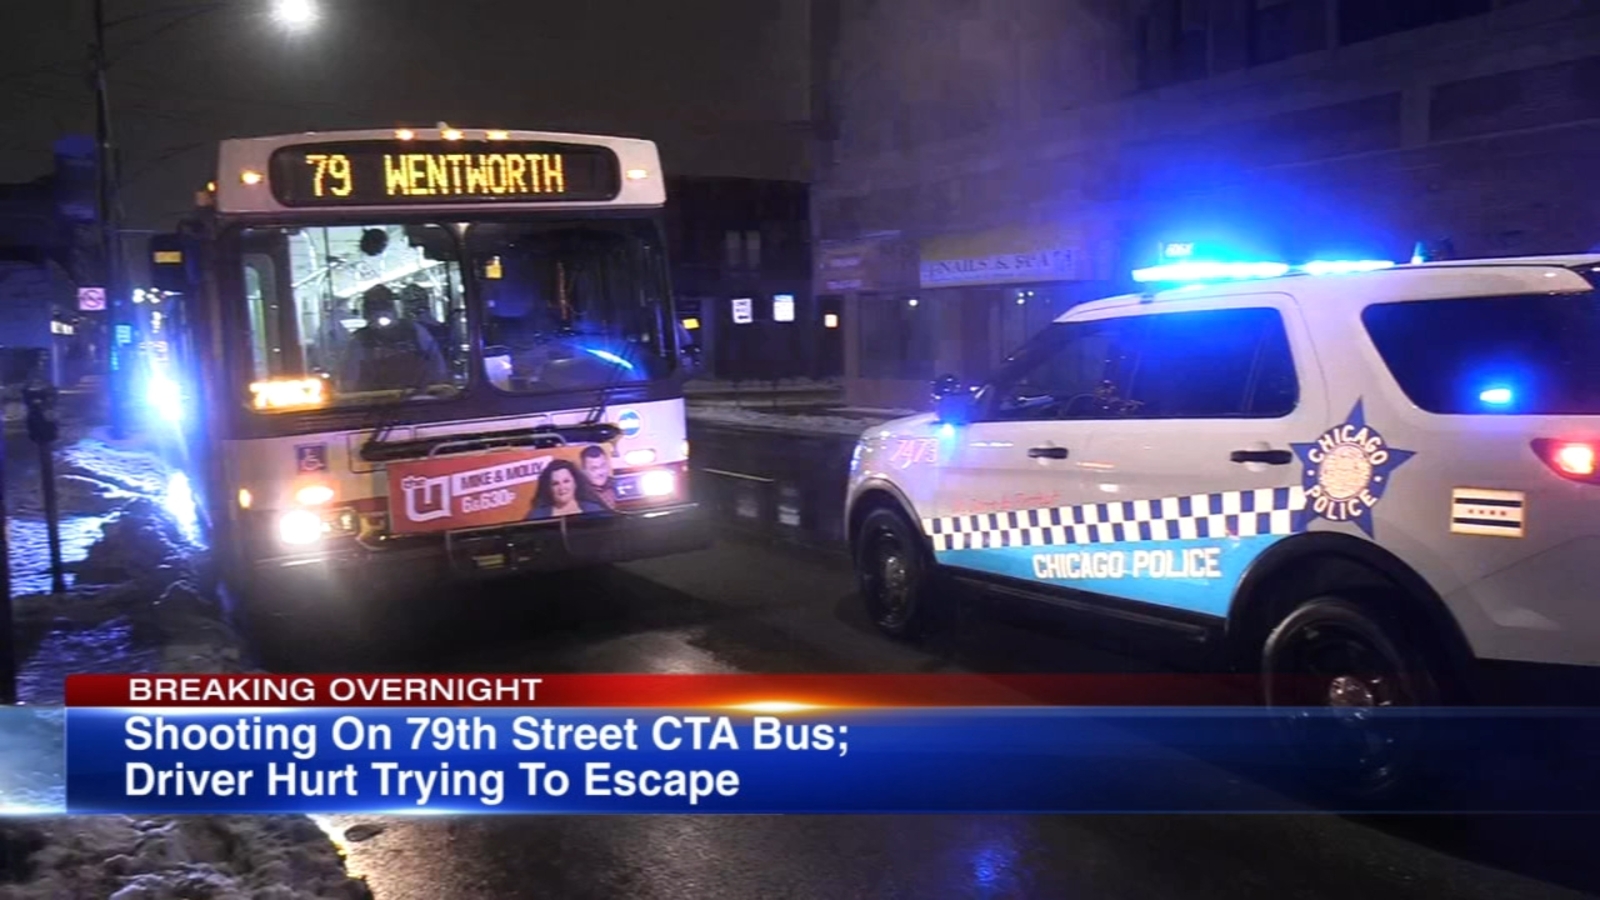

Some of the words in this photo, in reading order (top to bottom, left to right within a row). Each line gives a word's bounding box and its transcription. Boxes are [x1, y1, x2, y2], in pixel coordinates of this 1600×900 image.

[305, 154, 352, 196] 79
[384, 154, 565, 195] WENTWORTH
[1308, 424, 1389, 465] CHICAGO
[460, 471, 492, 490] MIKE
[506, 461, 544, 480] MOLLY
[1304, 484, 1378, 520] POLICE
[1032, 550, 1125, 579] CHICAGO
[1132, 547, 1223, 579] POLICE
